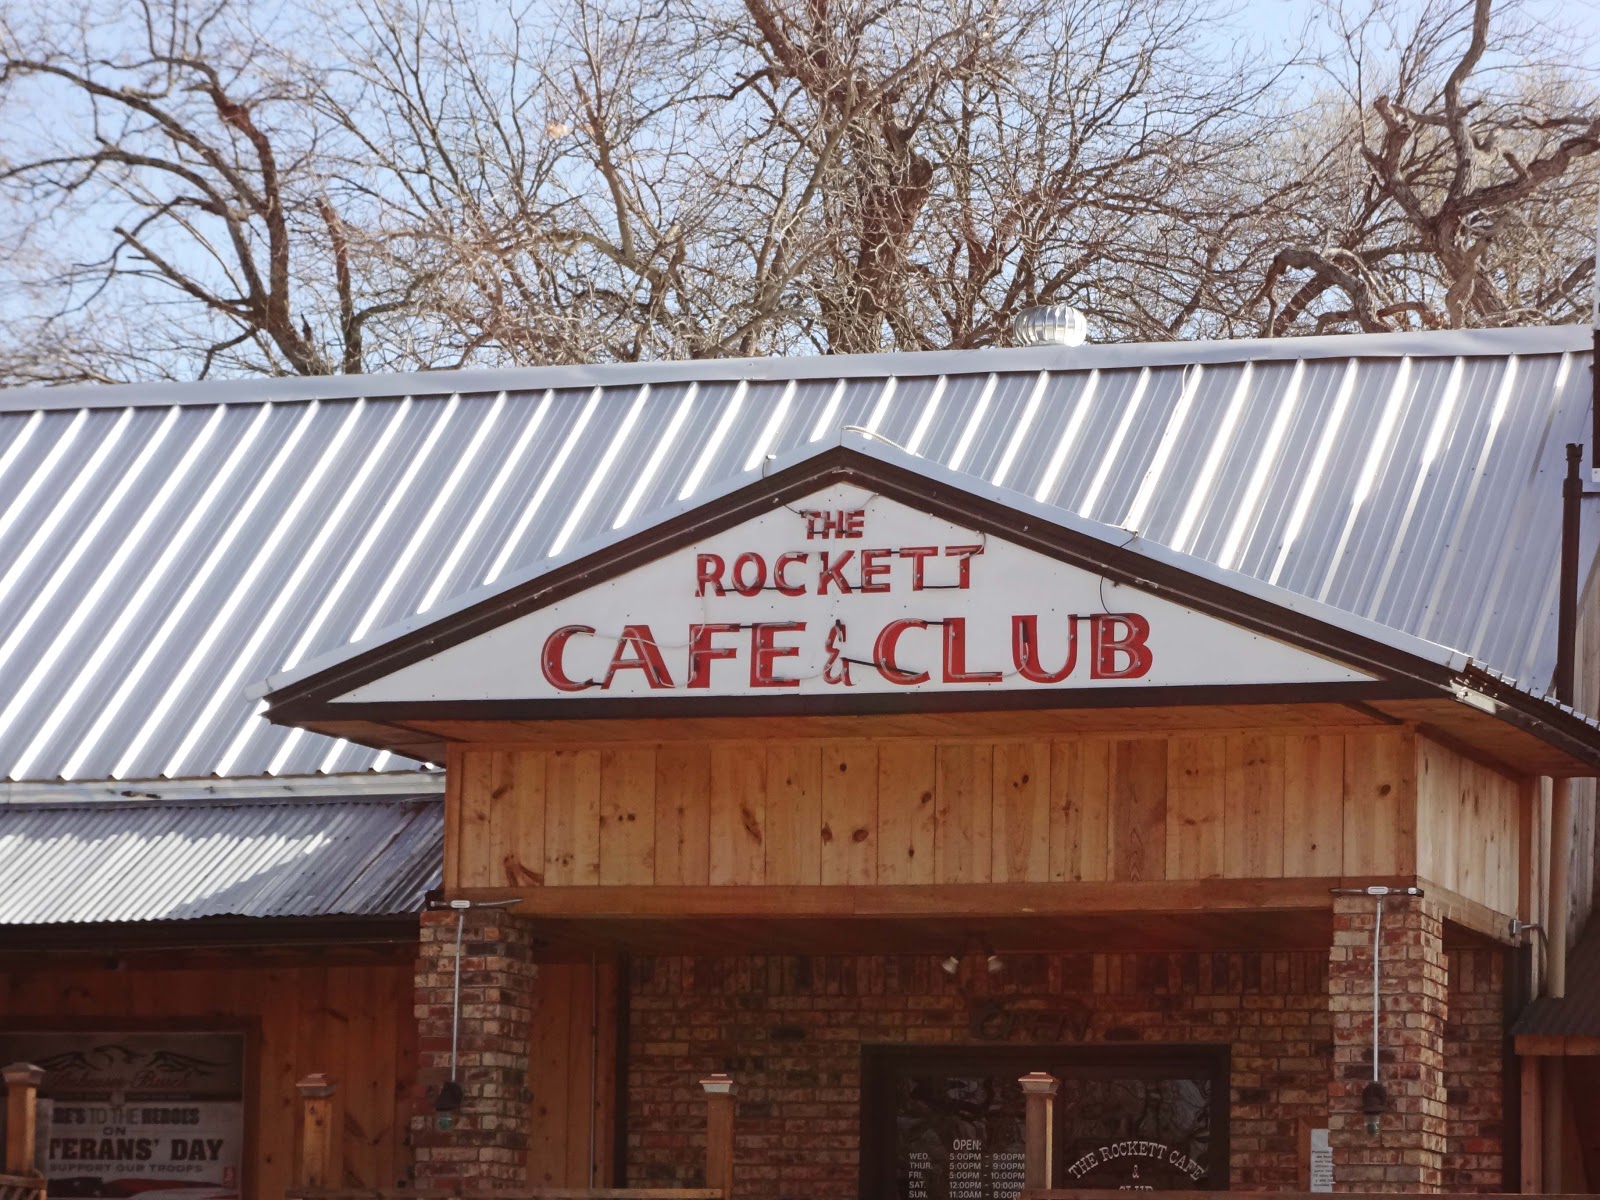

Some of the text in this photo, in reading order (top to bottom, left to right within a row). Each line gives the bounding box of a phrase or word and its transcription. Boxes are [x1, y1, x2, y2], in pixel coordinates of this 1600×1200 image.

[800, 509, 865, 539] THE
[694, 544, 985, 598] ROCKETT
[540, 612, 1154, 692] CAFE & CLUB
[89, 1107, 107, 1125] TO
[141, 1107, 200, 1126] HEROES
[103, 1126, 127, 1137] ON
[48, 1138, 224, 1161] TERANS' DAY
[952, 1138, 982, 1151] OPEN:
[50, 1163, 204, 1174] SUPPORT OUR TROOPS
[1067, 1140, 1205, 1181] THE ROCKETT CAFE
[1131, 1164, 1140, 1179] &
